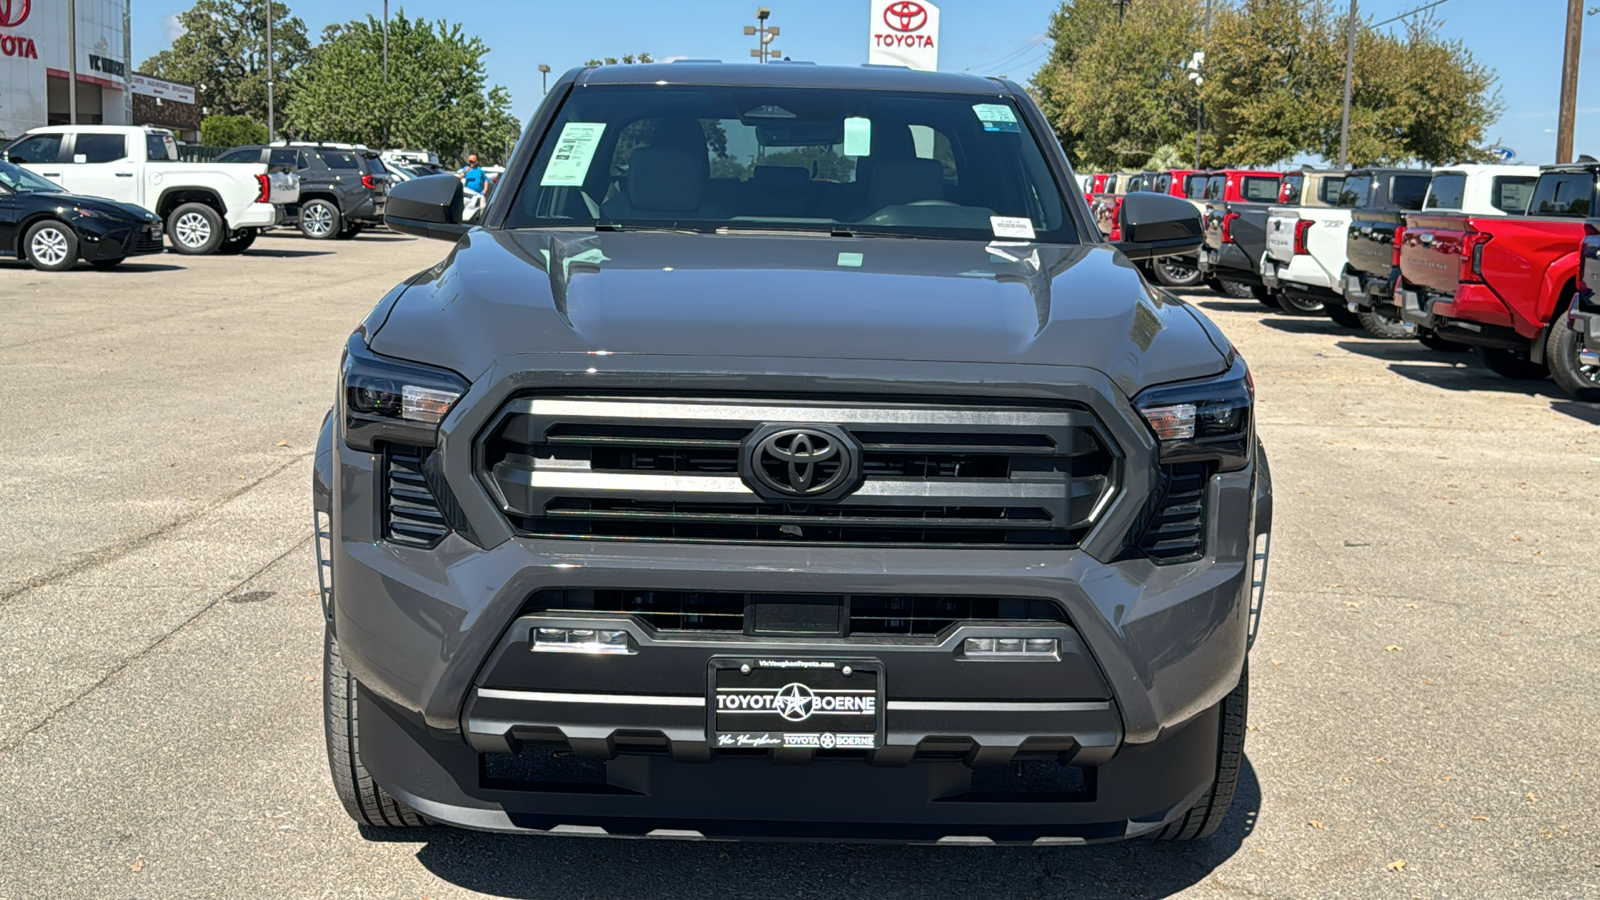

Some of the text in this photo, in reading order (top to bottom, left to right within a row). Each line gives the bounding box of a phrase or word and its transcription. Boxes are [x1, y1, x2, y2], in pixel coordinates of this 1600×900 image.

[0, 33, 38, 60] OTA
[874, 33, 934, 48] TOYOTA
[716, 695, 876, 710] TOYOTA BOERNE
[784, 736, 820, 745] TOYOTA
[836, 737, 874, 746] BOERNE
